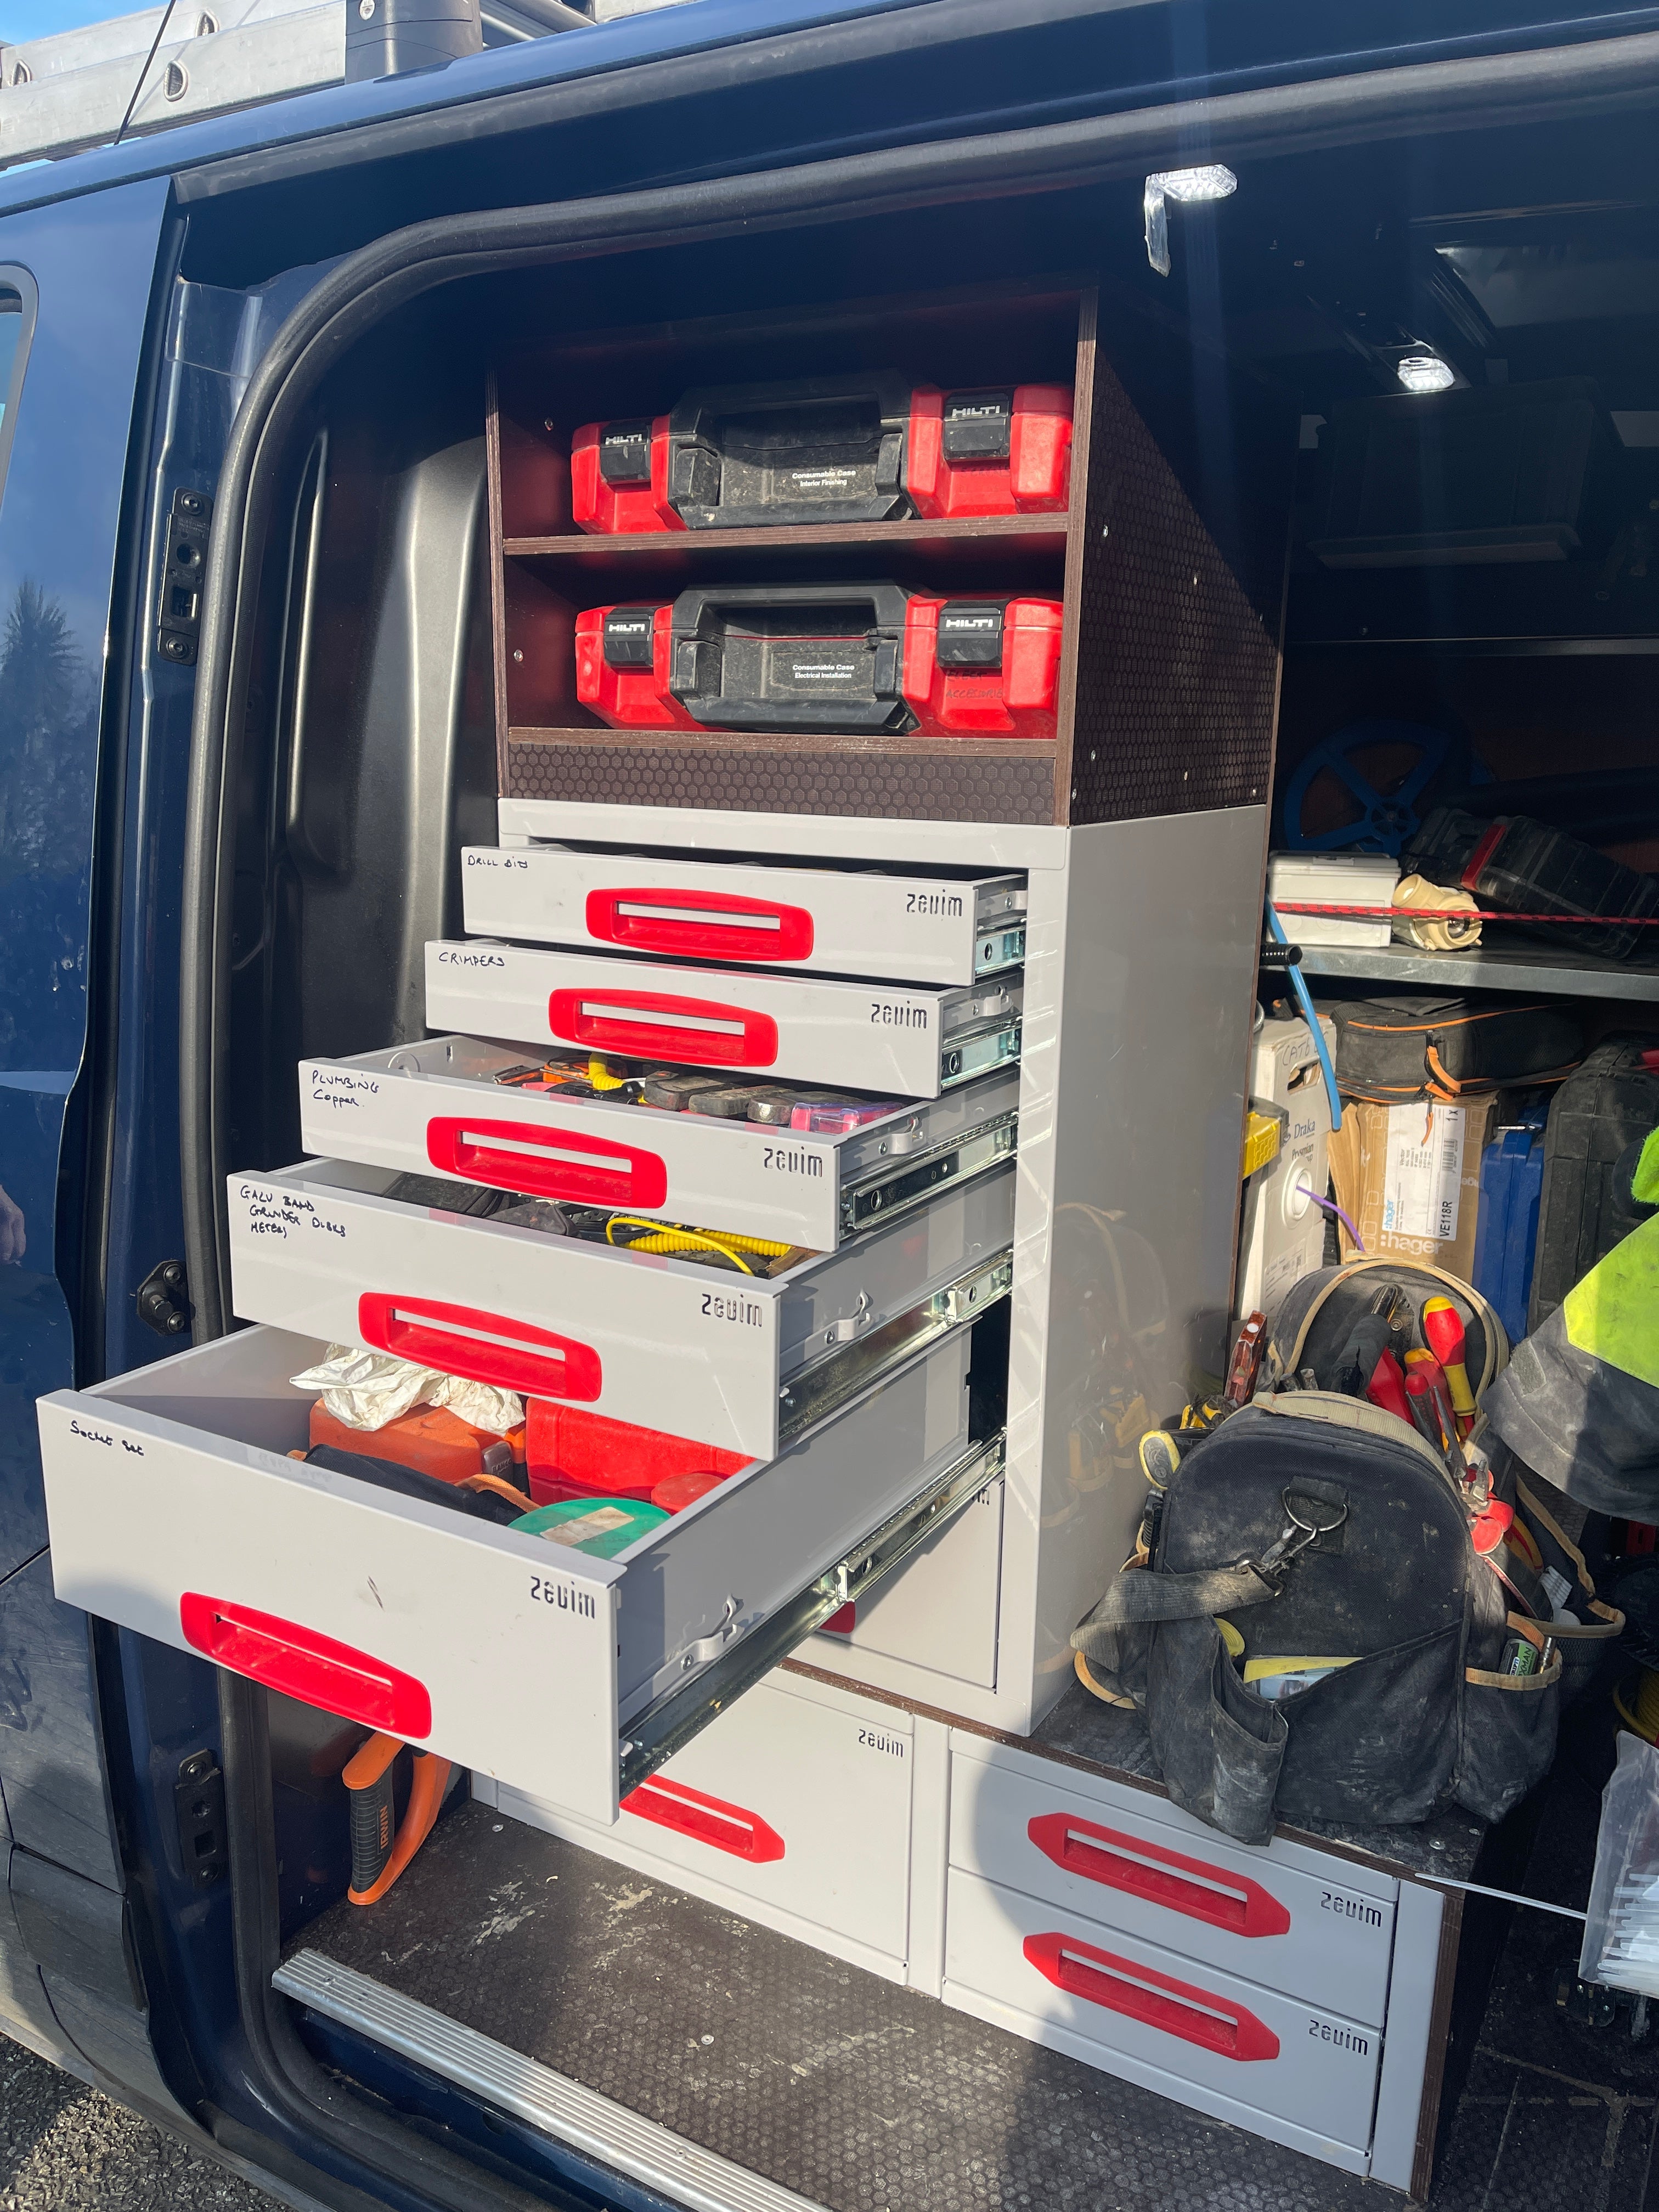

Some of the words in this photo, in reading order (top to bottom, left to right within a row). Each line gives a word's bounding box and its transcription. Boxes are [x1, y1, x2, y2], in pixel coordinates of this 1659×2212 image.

[952, 406, 1000, 417] HILTI
[605, 433, 642, 445] HILTI
[792, 471, 835, 479] Consumable
[608, 623, 645, 632] HILTI
[945, 619, 994, 628] HILTI
[439, 952, 505, 967] CRIMPERS
[1294, 1118, 1316, 1139] Draka
[1439, 1200, 1453, 1237] VE118R
[380, 1805, 388, 1849] IRWIN
